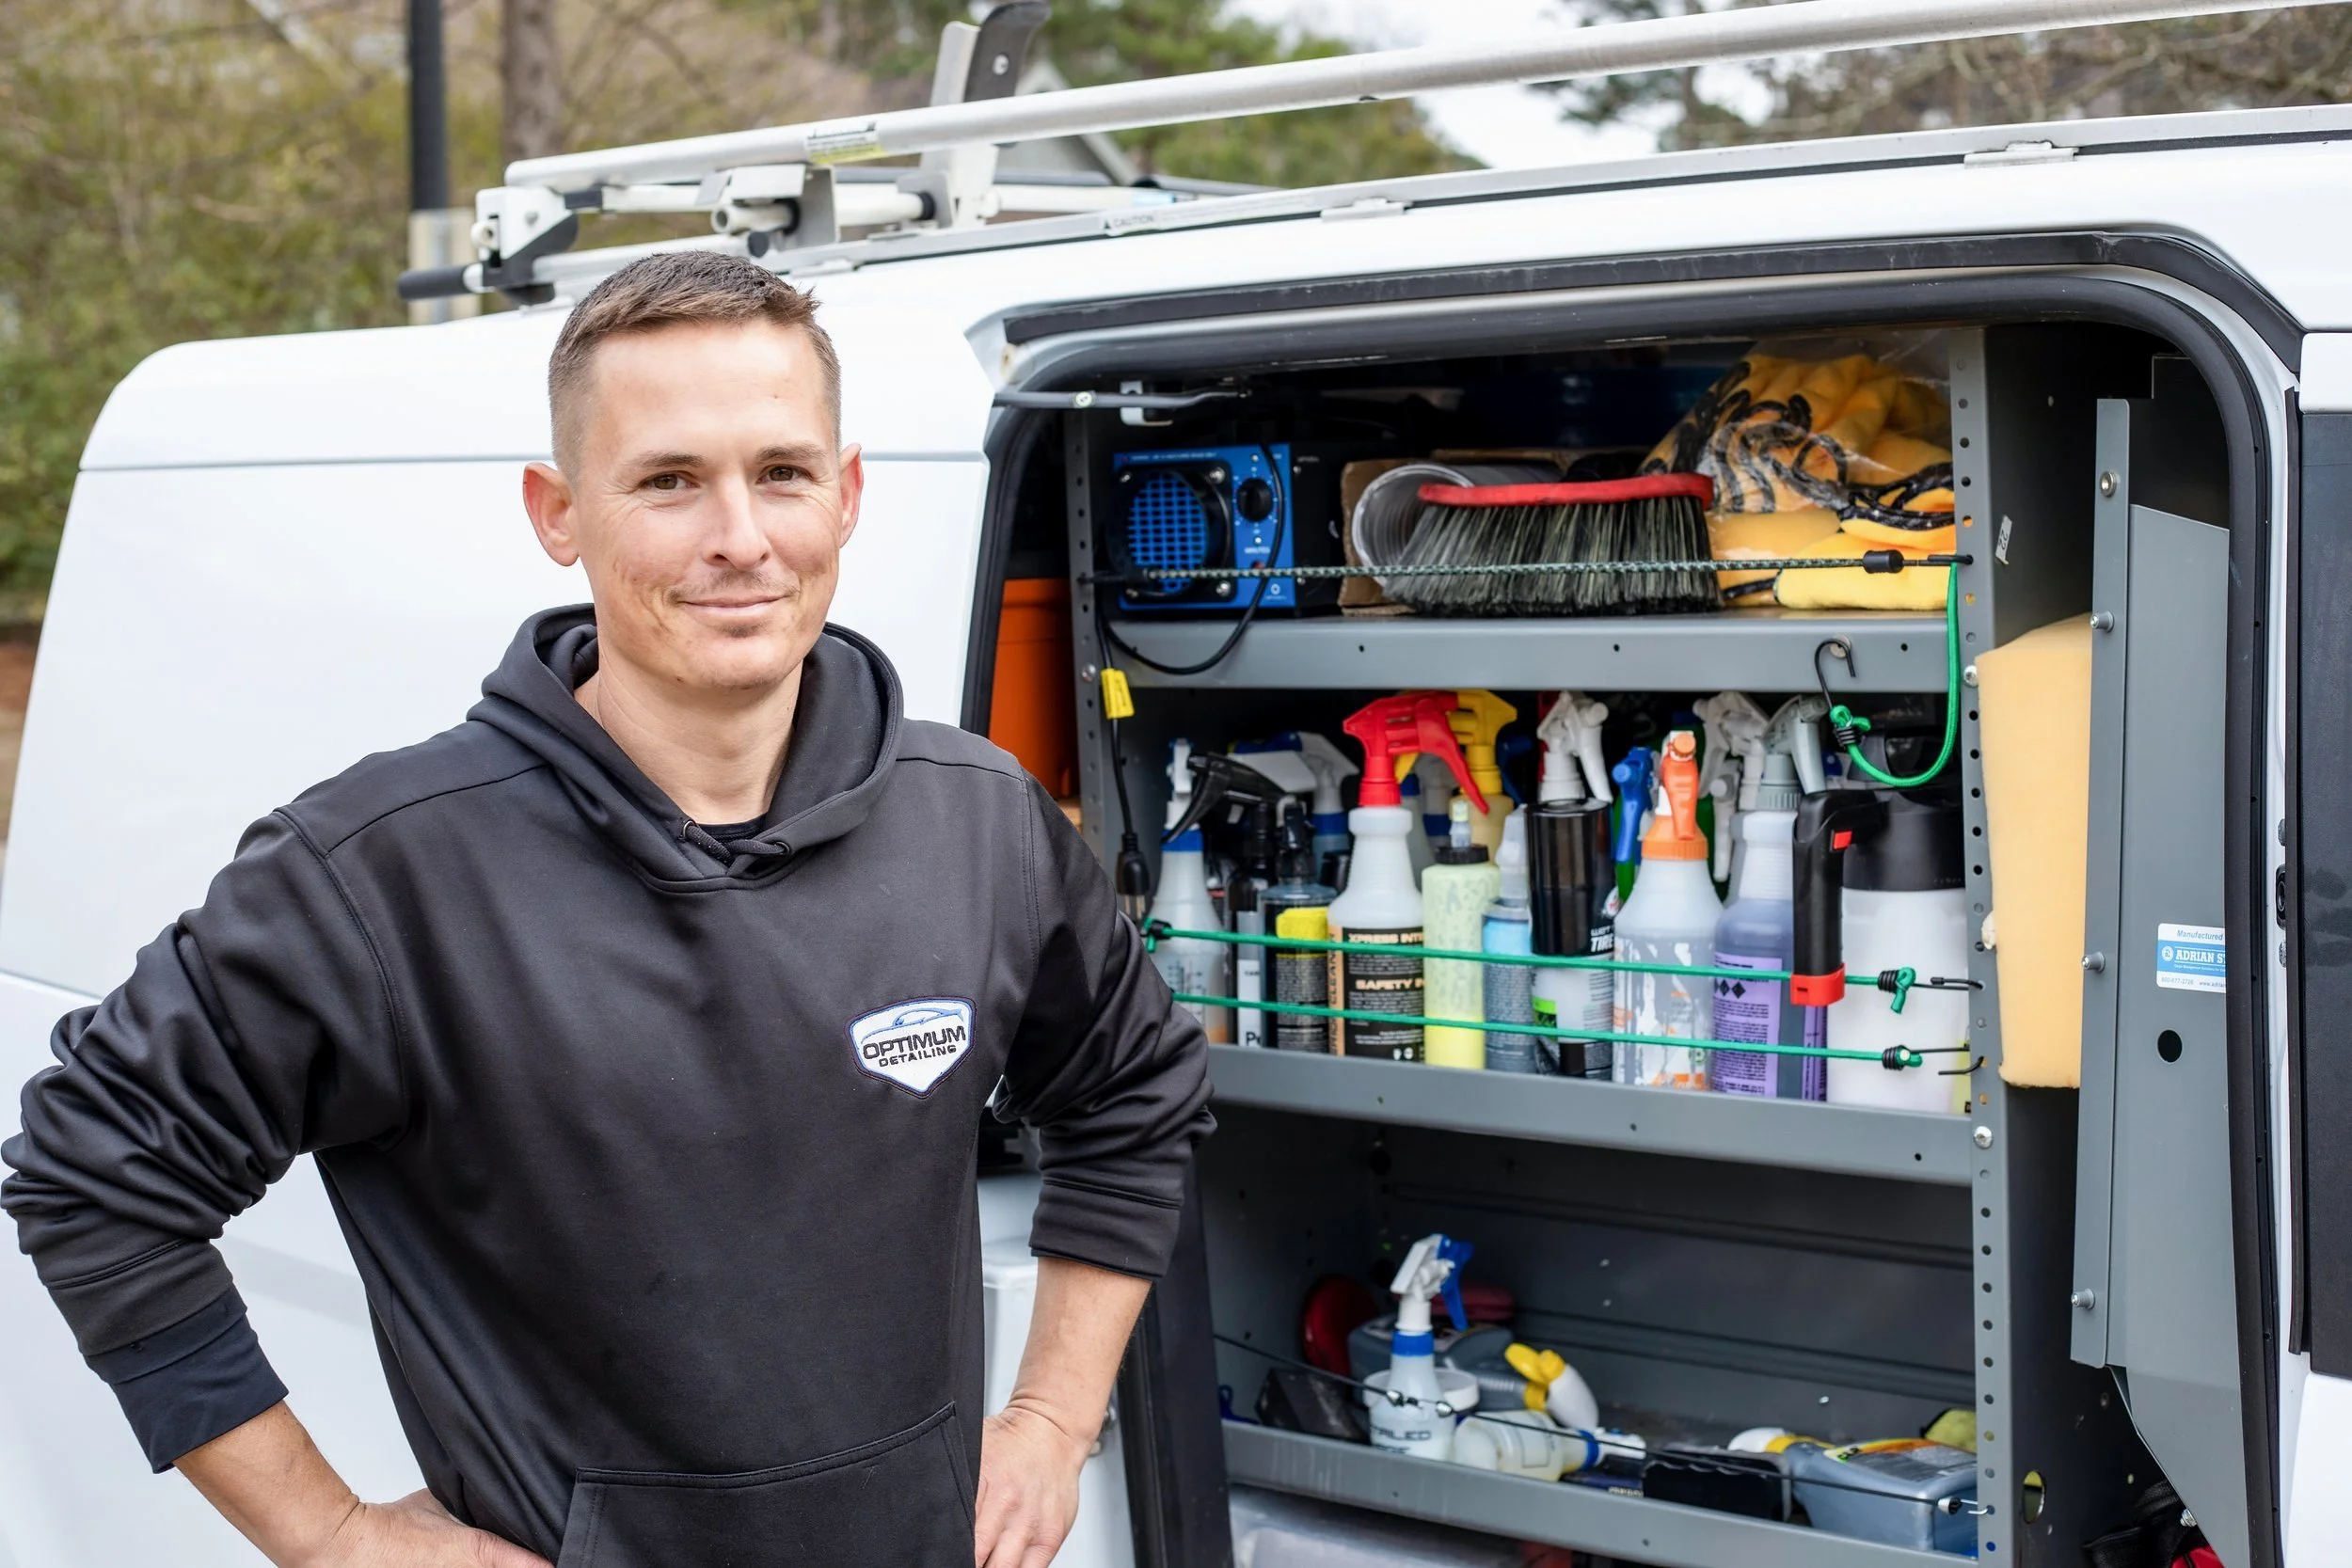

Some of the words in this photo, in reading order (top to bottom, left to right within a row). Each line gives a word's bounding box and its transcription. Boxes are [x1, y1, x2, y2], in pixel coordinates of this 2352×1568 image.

[1114, 214, 1154, 228] CAUTION
[1348, 933, 1399, 943] XPRESS
[2176, 929, 2224, 941] Manufactured
[2175, 949, 2215, 963] ADRIAN
[1356, 978, 1412, 990] SAFETY
[863, 1025, 966, 1060] OPTIMUM
[879, 1045, 957, 1068] DETAILING
